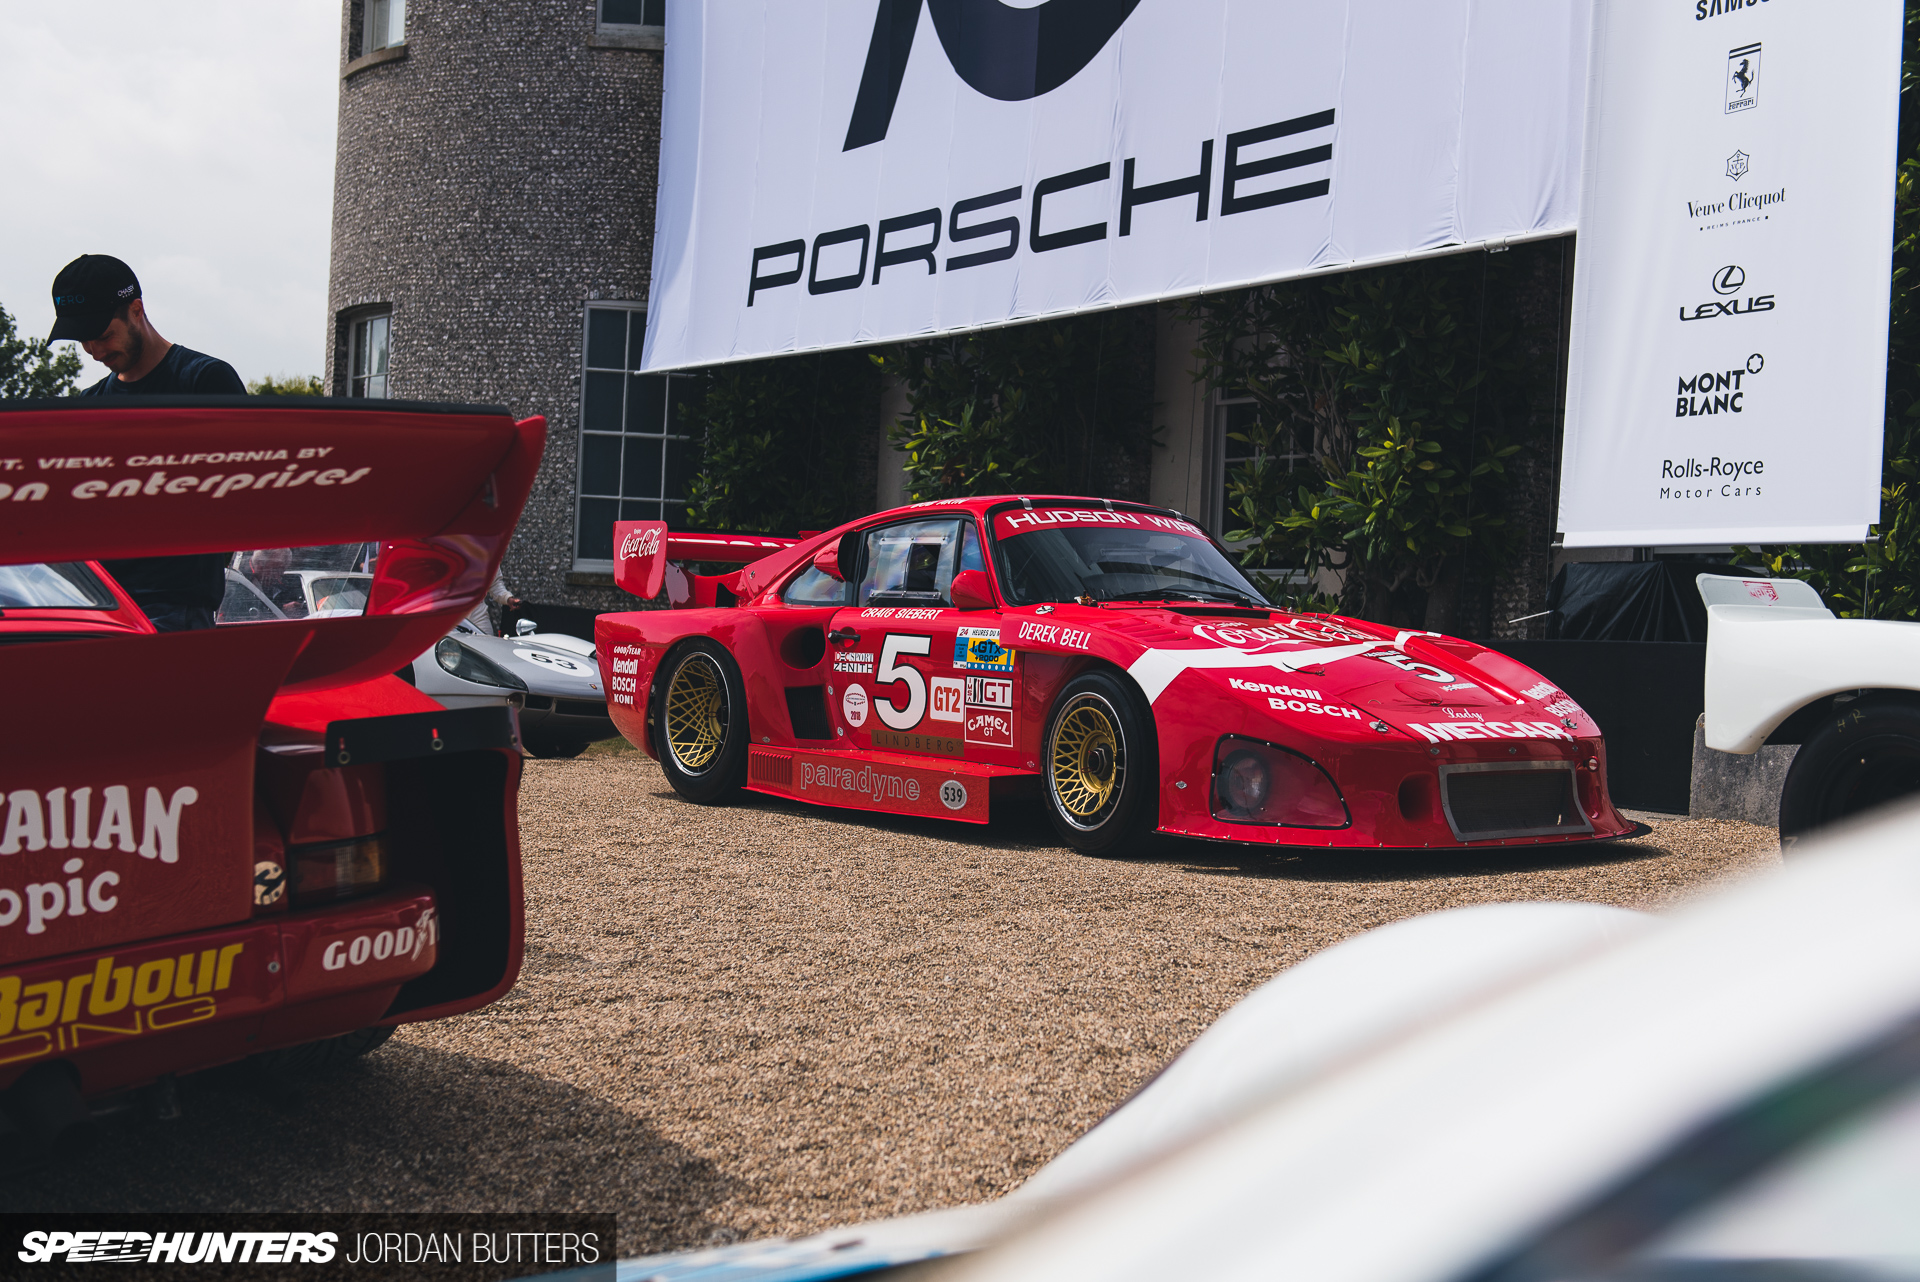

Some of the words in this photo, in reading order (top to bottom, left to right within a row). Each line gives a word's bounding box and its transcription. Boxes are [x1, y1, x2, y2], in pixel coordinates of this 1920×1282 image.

[1728, 97, 1755, 110] Ferrari
[747, 108, 1335, 308] PORSCHE
[1687, 200, 1726, 219] Veuve
[1729, 187, 1787, 212] Clicquot
[1707, 222, 1729, 231] REIMS
[1733, 216, 1761, 226] FRANCE
[1679, 295, 1776, 322] LEXUS
[1677, 369, 1746, 396] MONT
[1675, 392, 1744, 418] BLANC
[126, 449, 288, 467] CALIFORNIA
[297, 447, 335, 460] BY
[1662, 456, 1764, 481] Rolls-Royce
[71, 464, 372, 499] enterprises
[1659, 486, 1713, 500] Motor
[1721, 484, 1762, 498] Cars
[1005, 510, 1141, 529] HUDSON
[860, 608, 895, 619] CRAIG
[895, 609, 944, 621] SIEBERT
[959, 628, 969, 637] 24
[1018, 621, 1061, 645] DEREK
[1061, 629, 1092, 650] BELL
[613, 644, 642, 657] GOODYEAR
[531, 653, 578, 670] 53
[612, 657, 639, 675] Kendall
[833, 662, 874, 674] ZENITH
[1373, 654, 1457, 683] 5
[612, 676, 636, 693] BOSCH
[873, 631, 932, 732] 5
[1228, 678, 1322, 701] Kendall
[614, 693, 634, 705] KONI
[933, 685, 961, 714] GT2
[984, 682, 1011, 704] GT
[1268, 697, 1362, 721] BOSCH
[1441, 706, 1485, 722] Lady
[967, 714, 1010, 736] CAMEL
[983, 727, 994, 737] GT
[876, 732, 954, 753] LINDBERG
[800, 762, 920, 802] paradyne
[943, 786, 963, 803] 539
